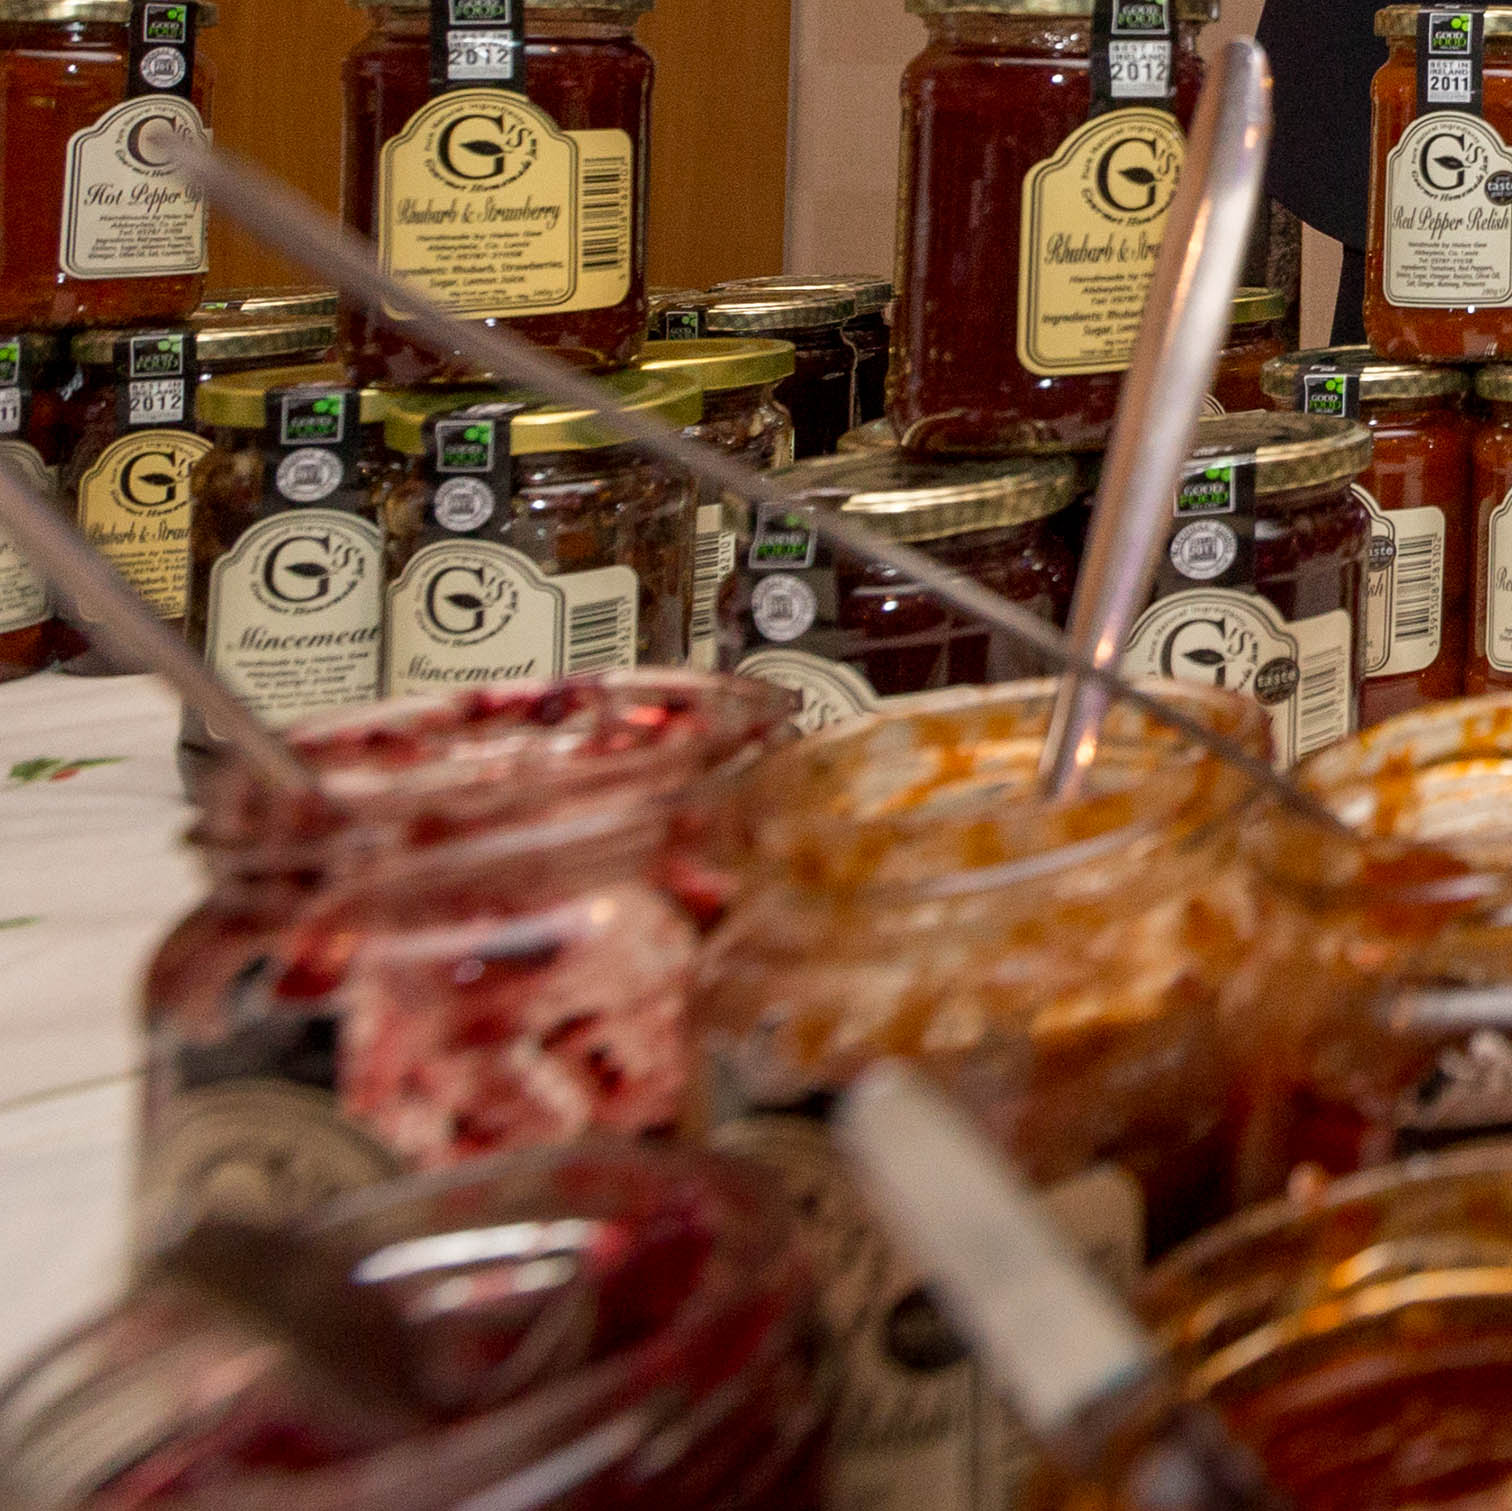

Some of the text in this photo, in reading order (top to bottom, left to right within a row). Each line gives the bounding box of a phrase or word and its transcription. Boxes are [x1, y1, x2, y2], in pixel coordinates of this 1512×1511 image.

[449, 48, 508, 65] 2012
[1111, 63, 1166, 81] 2012
[1430, 76, 1469, 91] 2011
[438, 114, 533, 180] G's
[1419, 133, 1485, 190] G's
[1098, 137, 1177, 212] G's
[84, 183, 181, 213] Hot Pepper
[477, 194, 560, 231] Strawberry
[1393, 205, 1509, 240] Red Pepper Relish
[1044, 232, 1113, 264] Rhubarb
[130, 395, 182, 412] 2012
[264, 535, 358, 602] G's
[426, 565, 515, 635] G's
[400, 655, 537, 681] Mincemeat
